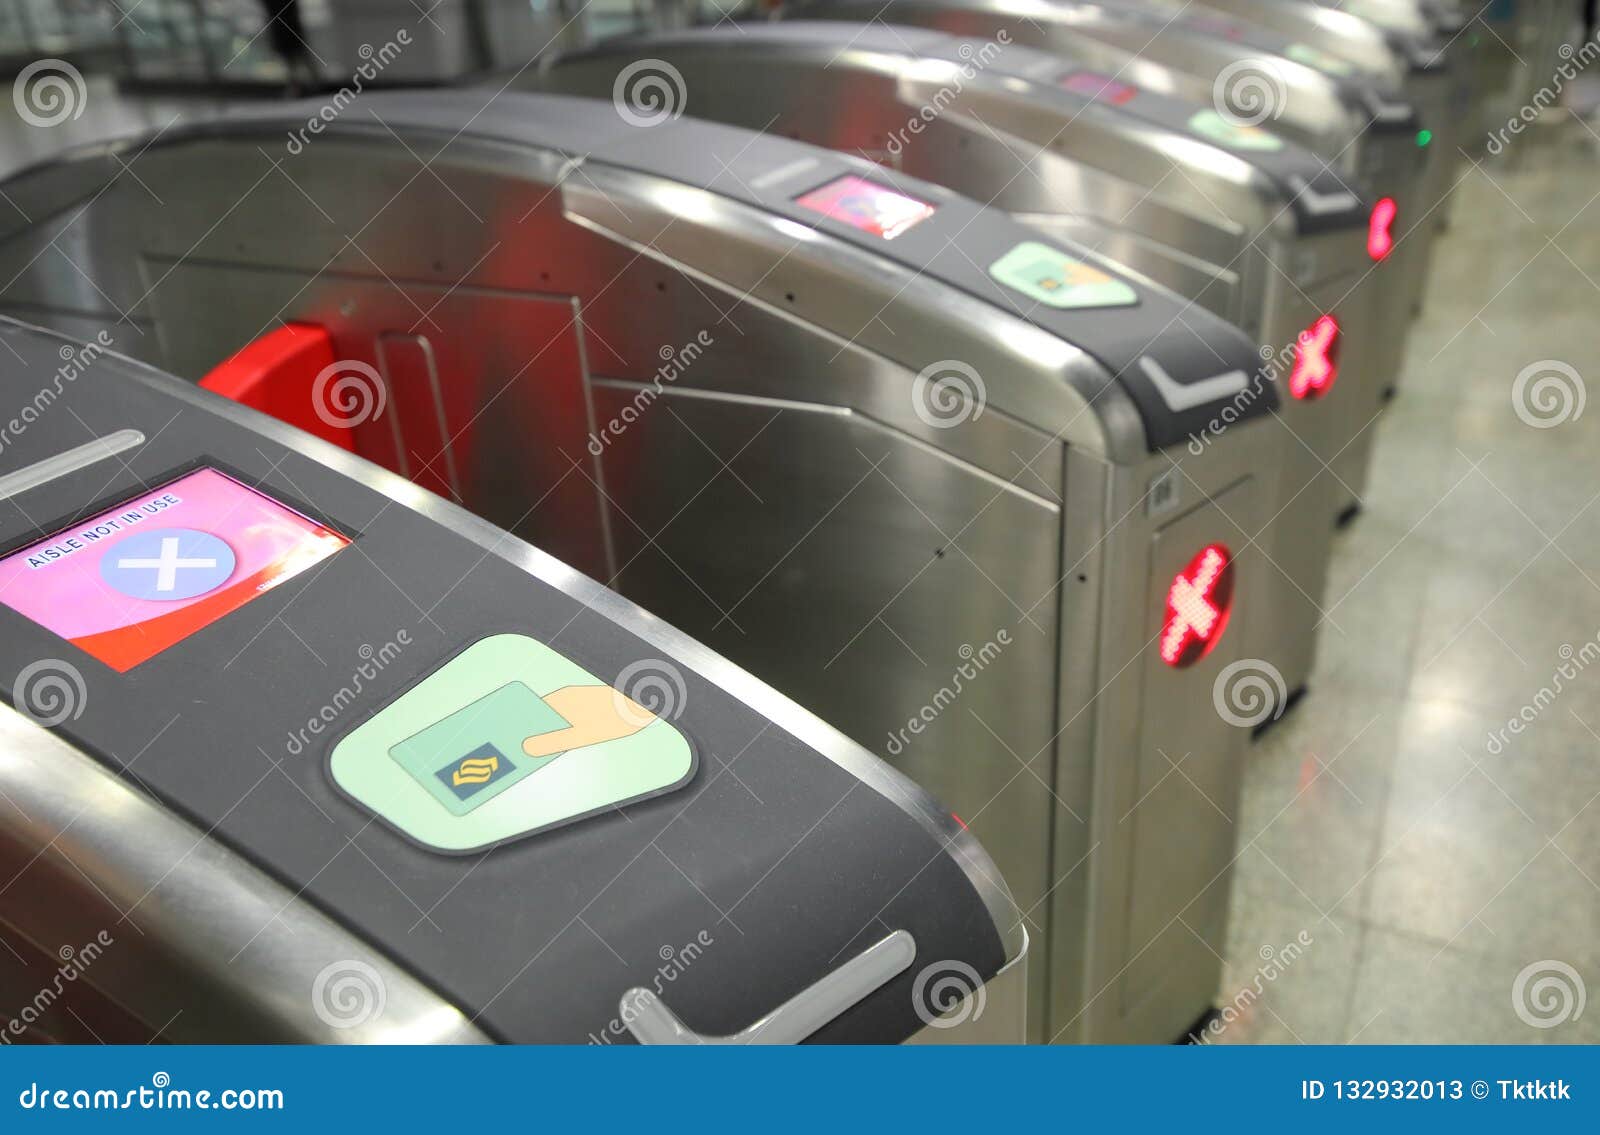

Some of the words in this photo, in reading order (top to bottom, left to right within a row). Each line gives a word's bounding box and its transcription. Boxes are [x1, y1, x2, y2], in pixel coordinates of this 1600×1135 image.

[27, 538, 84, 568] AISLE
[82, 520, 121, 542] NOT
[120, 511, 144, 524] IN
[142, 494, 180, 514] USE
